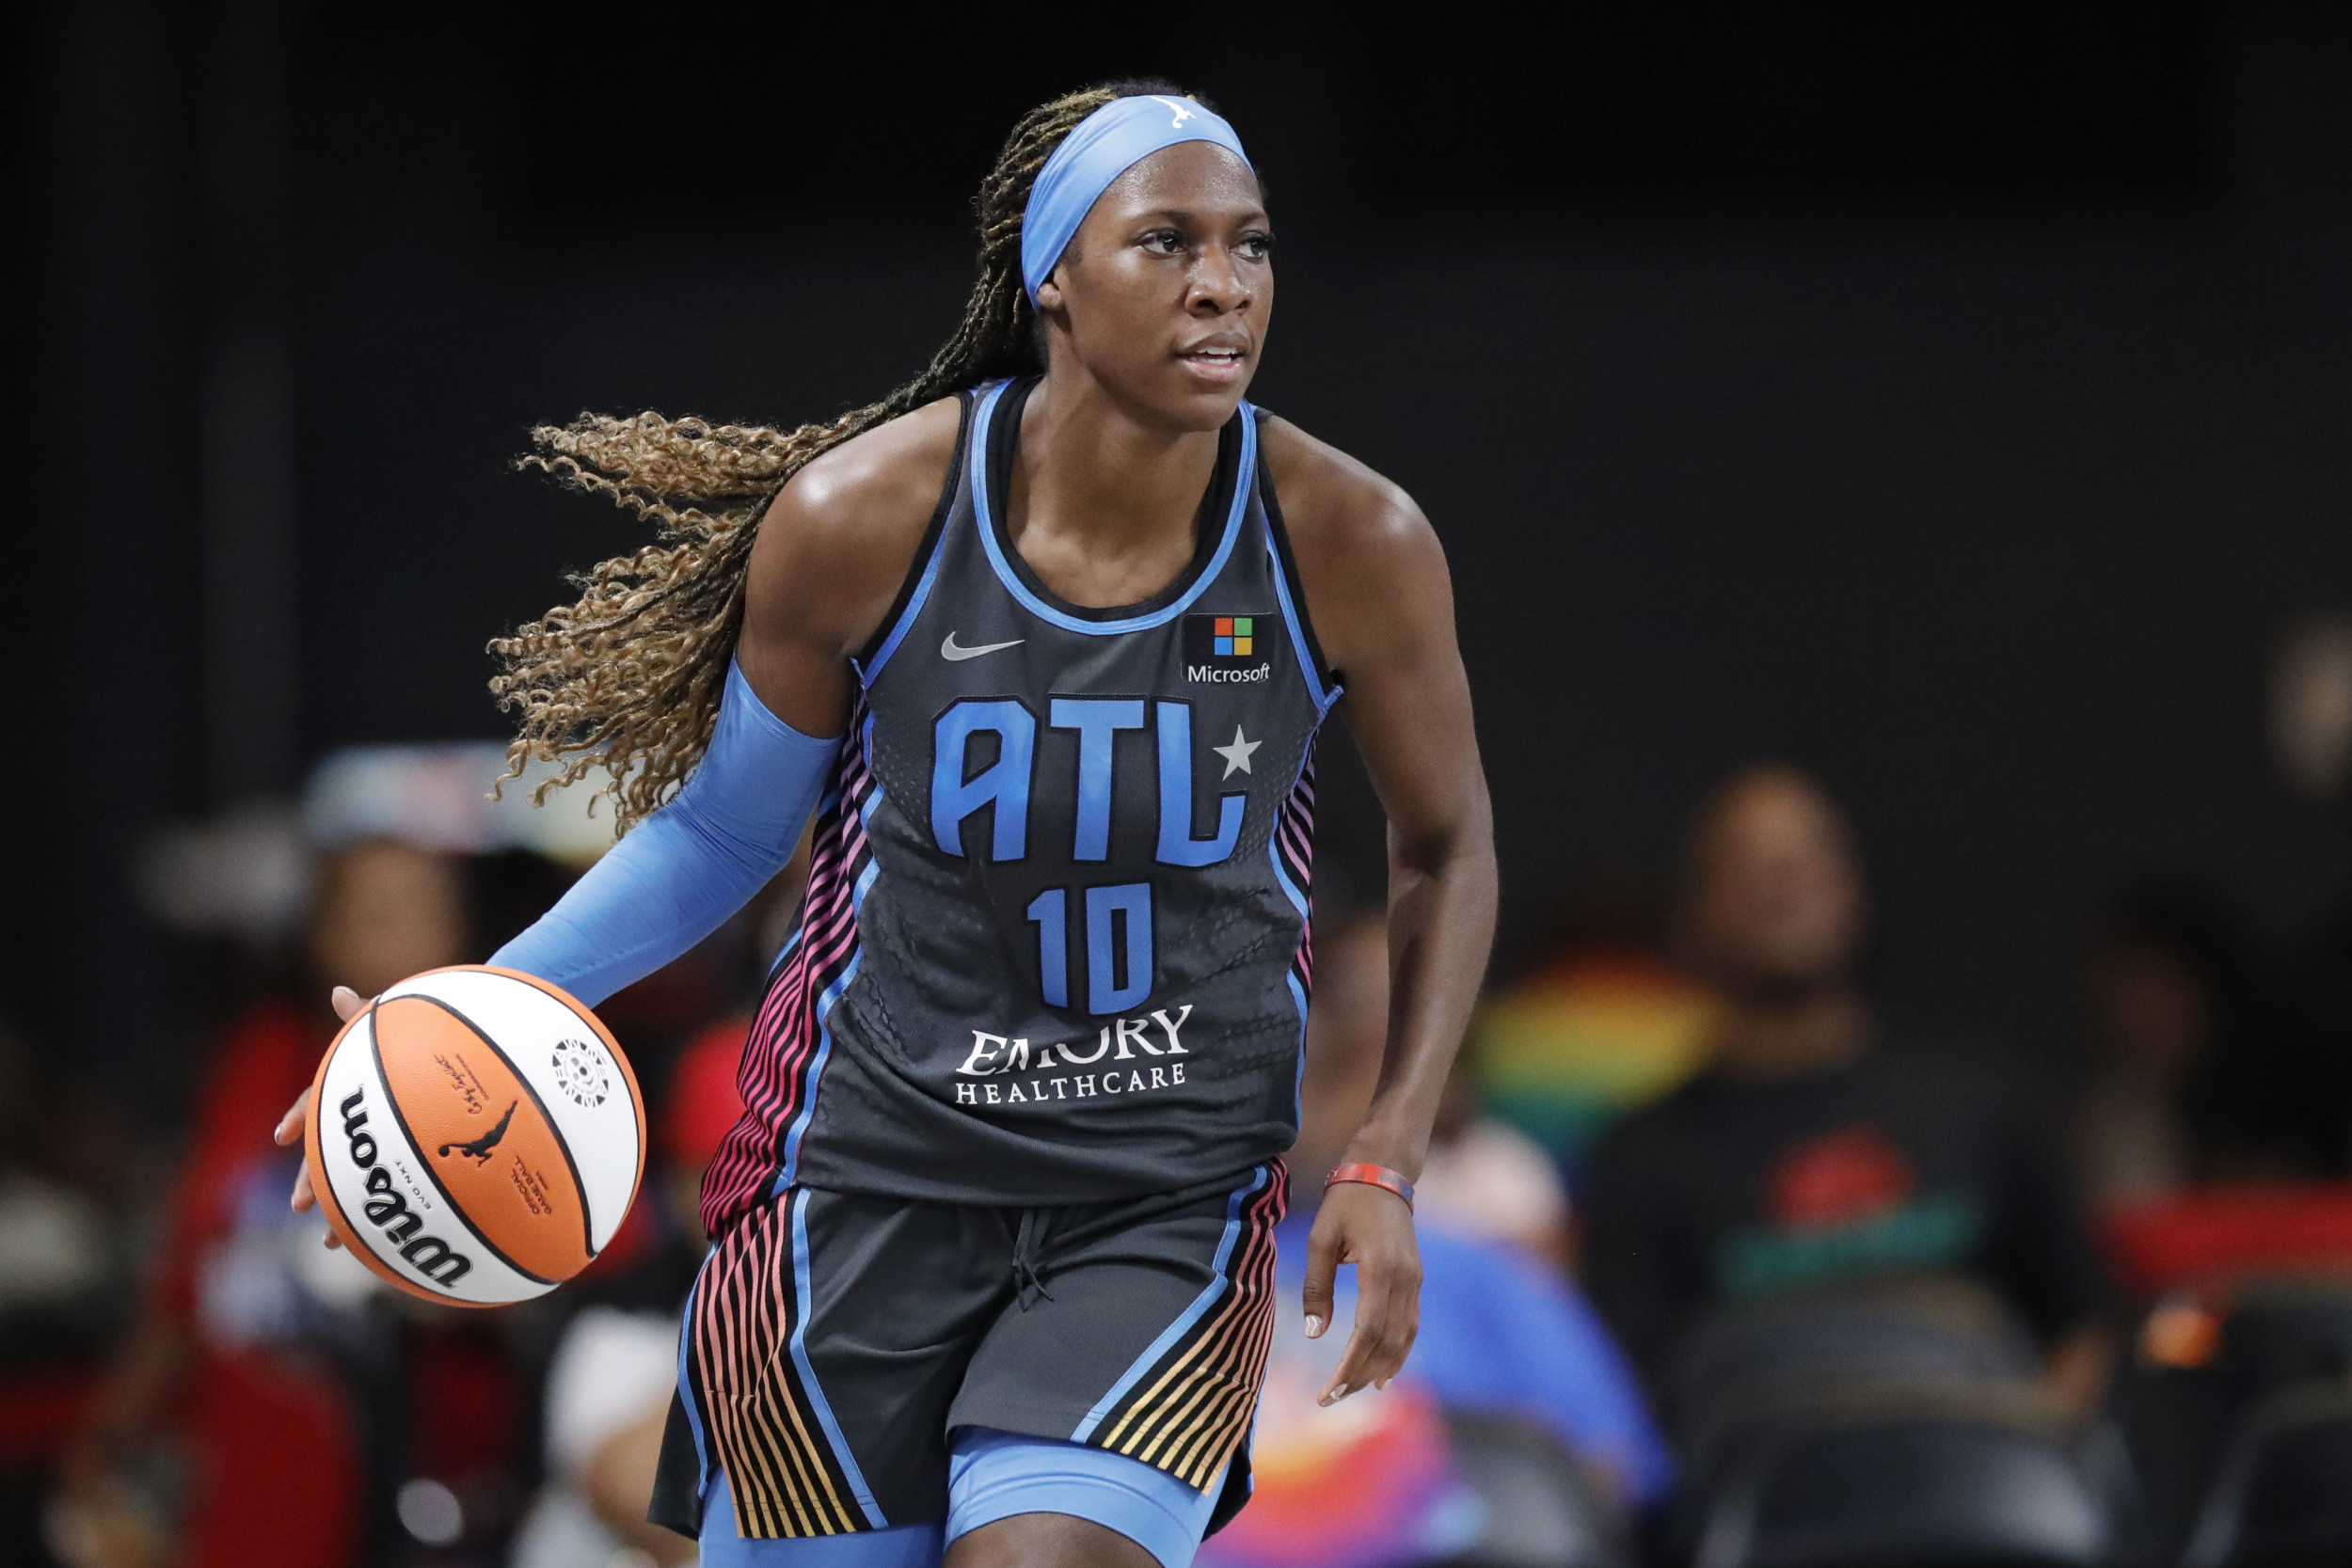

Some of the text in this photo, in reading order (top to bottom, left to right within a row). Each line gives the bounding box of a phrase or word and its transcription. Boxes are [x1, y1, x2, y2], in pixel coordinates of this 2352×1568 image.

[1187, 662, 1271, 683] Microsoft
[930, 698, 1246, 867] ATL
[1026, 883, 1153, 1015] 10
[955, 1063, 1185, 1104] HEALTHCARE
[340, 1084, 473, 1289] Wilson
[395, 1161, 432, 1210] EVO NXT
[511, 1168, 540, 1214] OFFICIAL
[515, 1156, 533, 1185] BALL
[531, 1184, 552, 1214] GAME
